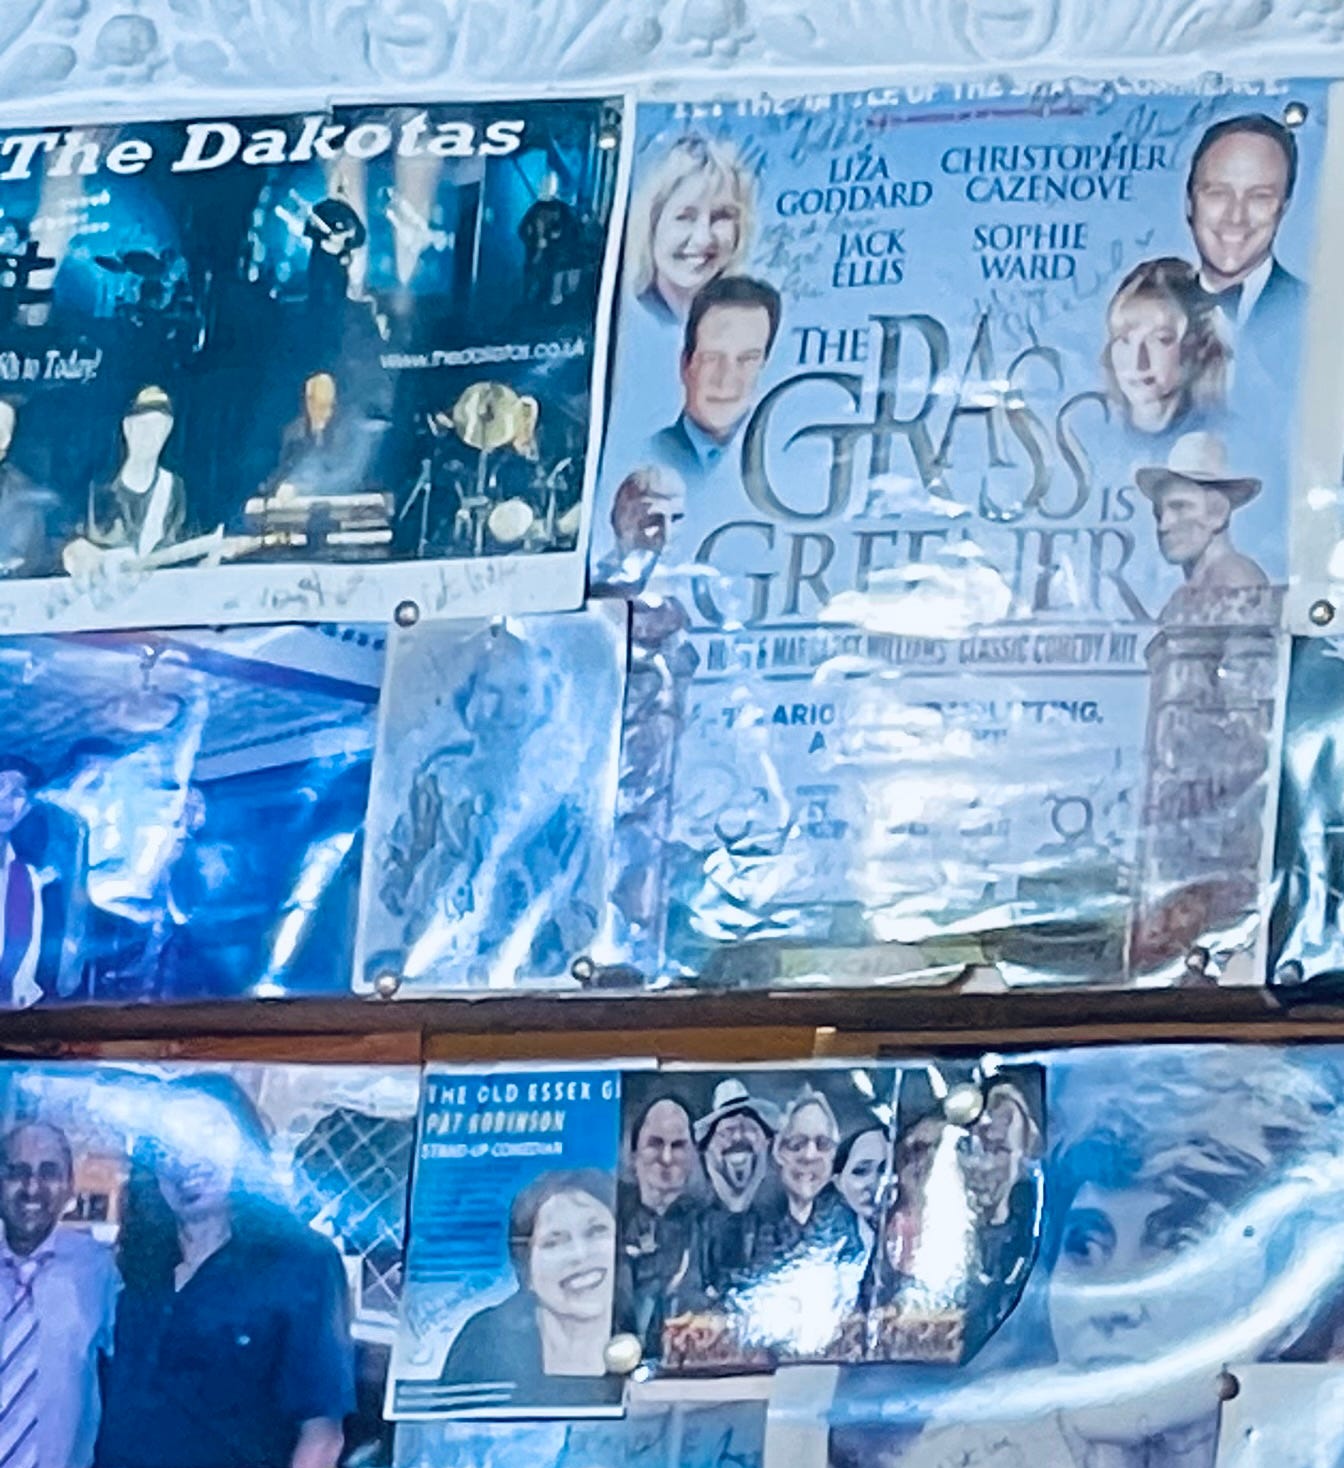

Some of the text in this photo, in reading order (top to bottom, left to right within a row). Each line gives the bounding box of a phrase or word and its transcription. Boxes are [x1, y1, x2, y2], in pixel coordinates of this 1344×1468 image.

[2, 112, 525, 181] The Dakotas
[829, 144, 1167, 184] LIZA CHRISTOPHER
[776, 175, 1133, 217] GODDARD CAZENOVE
[838, 223, 1088, 260] JACK SOPHIE
[832, 254, 1077, 290] ELLIS WARD
[792, 325, 869, 366] THE
[1100, 486, 1137, 522] IS
[477, 1083, 518, 1103] OLD
[527, 1081, 591, 1102] ESSEX
